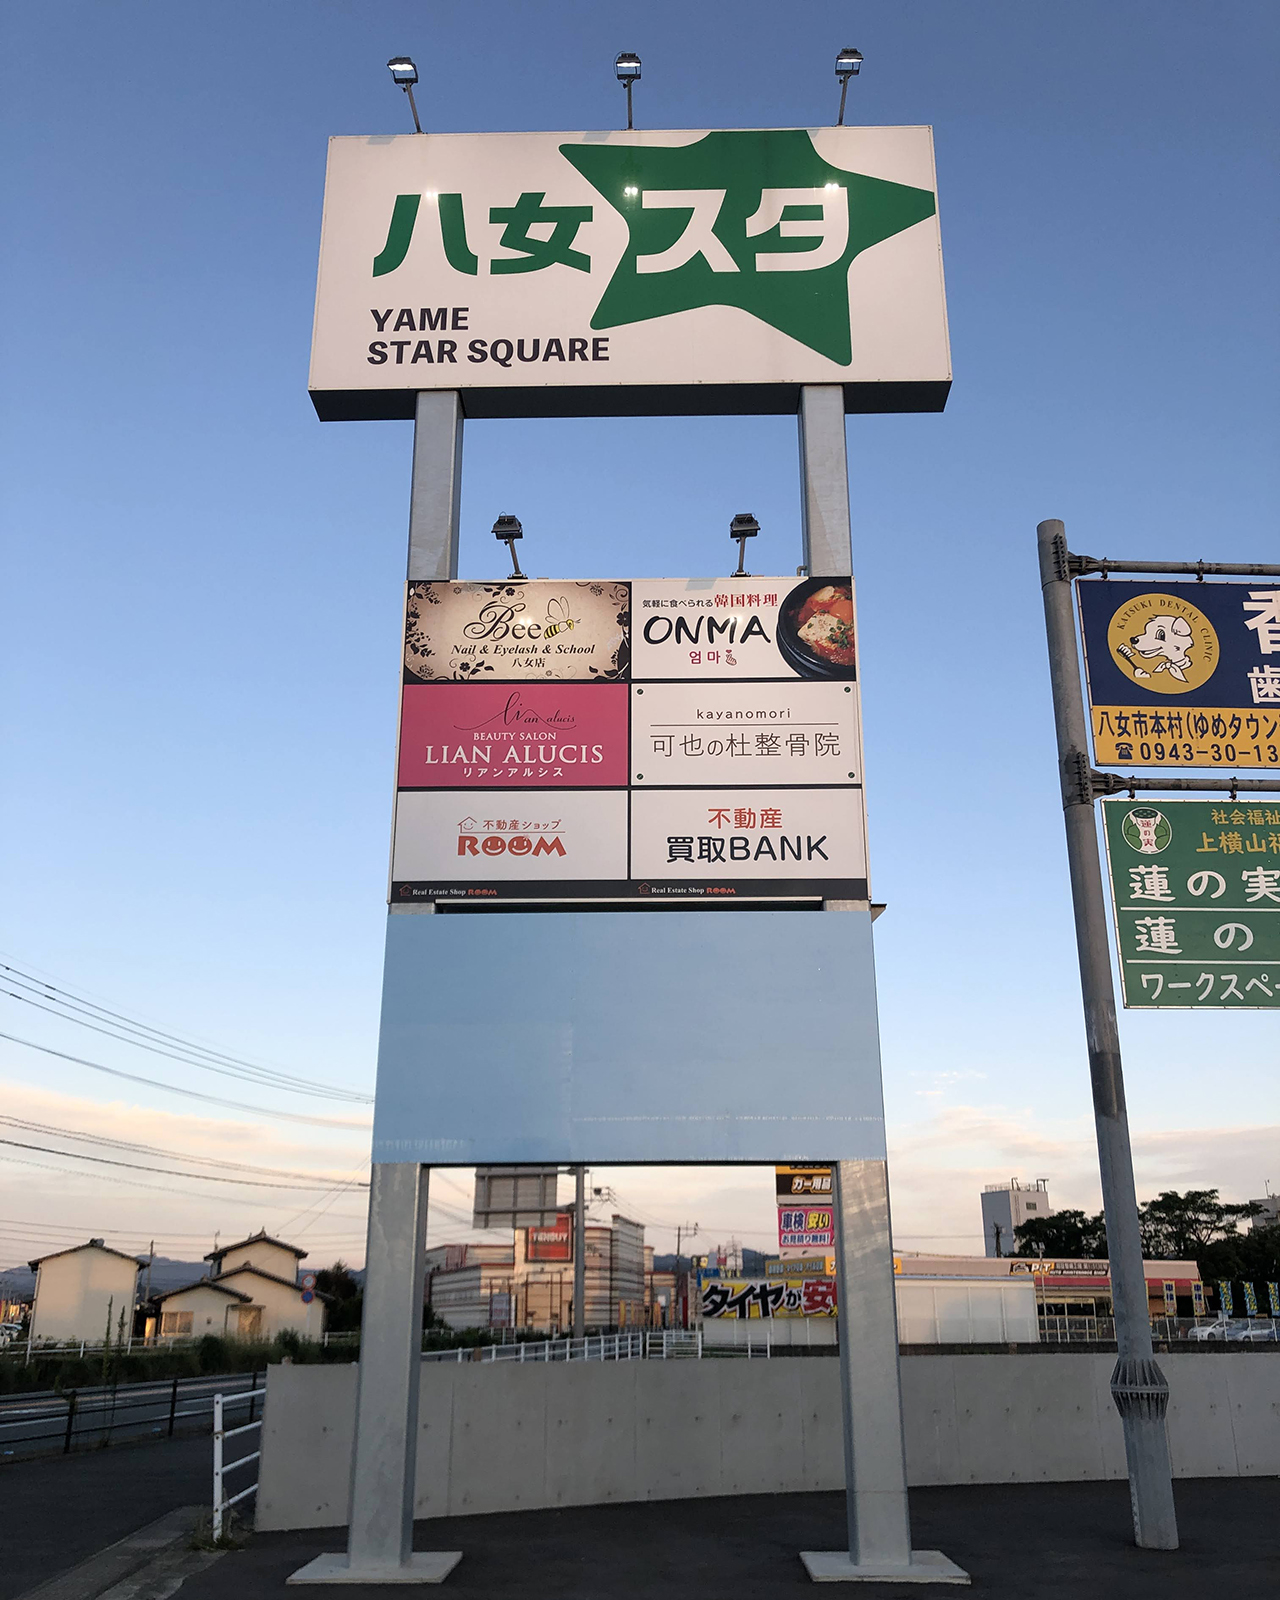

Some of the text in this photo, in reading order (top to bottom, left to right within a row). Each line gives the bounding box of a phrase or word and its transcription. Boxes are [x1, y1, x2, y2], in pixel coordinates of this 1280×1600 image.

[372, 186, 849, 278] 八女スタ
[370, 307, 470, 333] YAME
[367, 336, 610, 368] STAR SQUARE
[462, 600, 542, 642] Bee
[643, 615, 772, 645] ONMA
[1116, 598, 1213, 663] KATSUKI DENTAL CLINIC
[451, 644, 596, 656] Nail & Eyelash & School
[511, 657, 546, 669] 八女店
[696, 708, 792, 720] kayanomori
[1098, 710, 1280, 740] 八女市本村(ゆめタウン
[473, 732, 557, 741] BEAUTY SALON
[650, 731, 841, 758] 可也の杜整骨院
[425, 744, 604, 764] LIAN ALUCIS
[463, 767, 564, 778] リアンアルシス
[482, 818, 563, 831] 不動産ショップ
[708, 807, 783, 830] 不動産
[457, 835, 567, 857] ROOM
[666, 835, 829, 864] 買取BANK
[412, 888, 428, 896] Real
[428, 888, 449, 896] Estate
[449, 888, 466, 897] Shop
[688, 886, 705, 895] Shop
[1140, 972, 1280, 1001] ワークスペ
